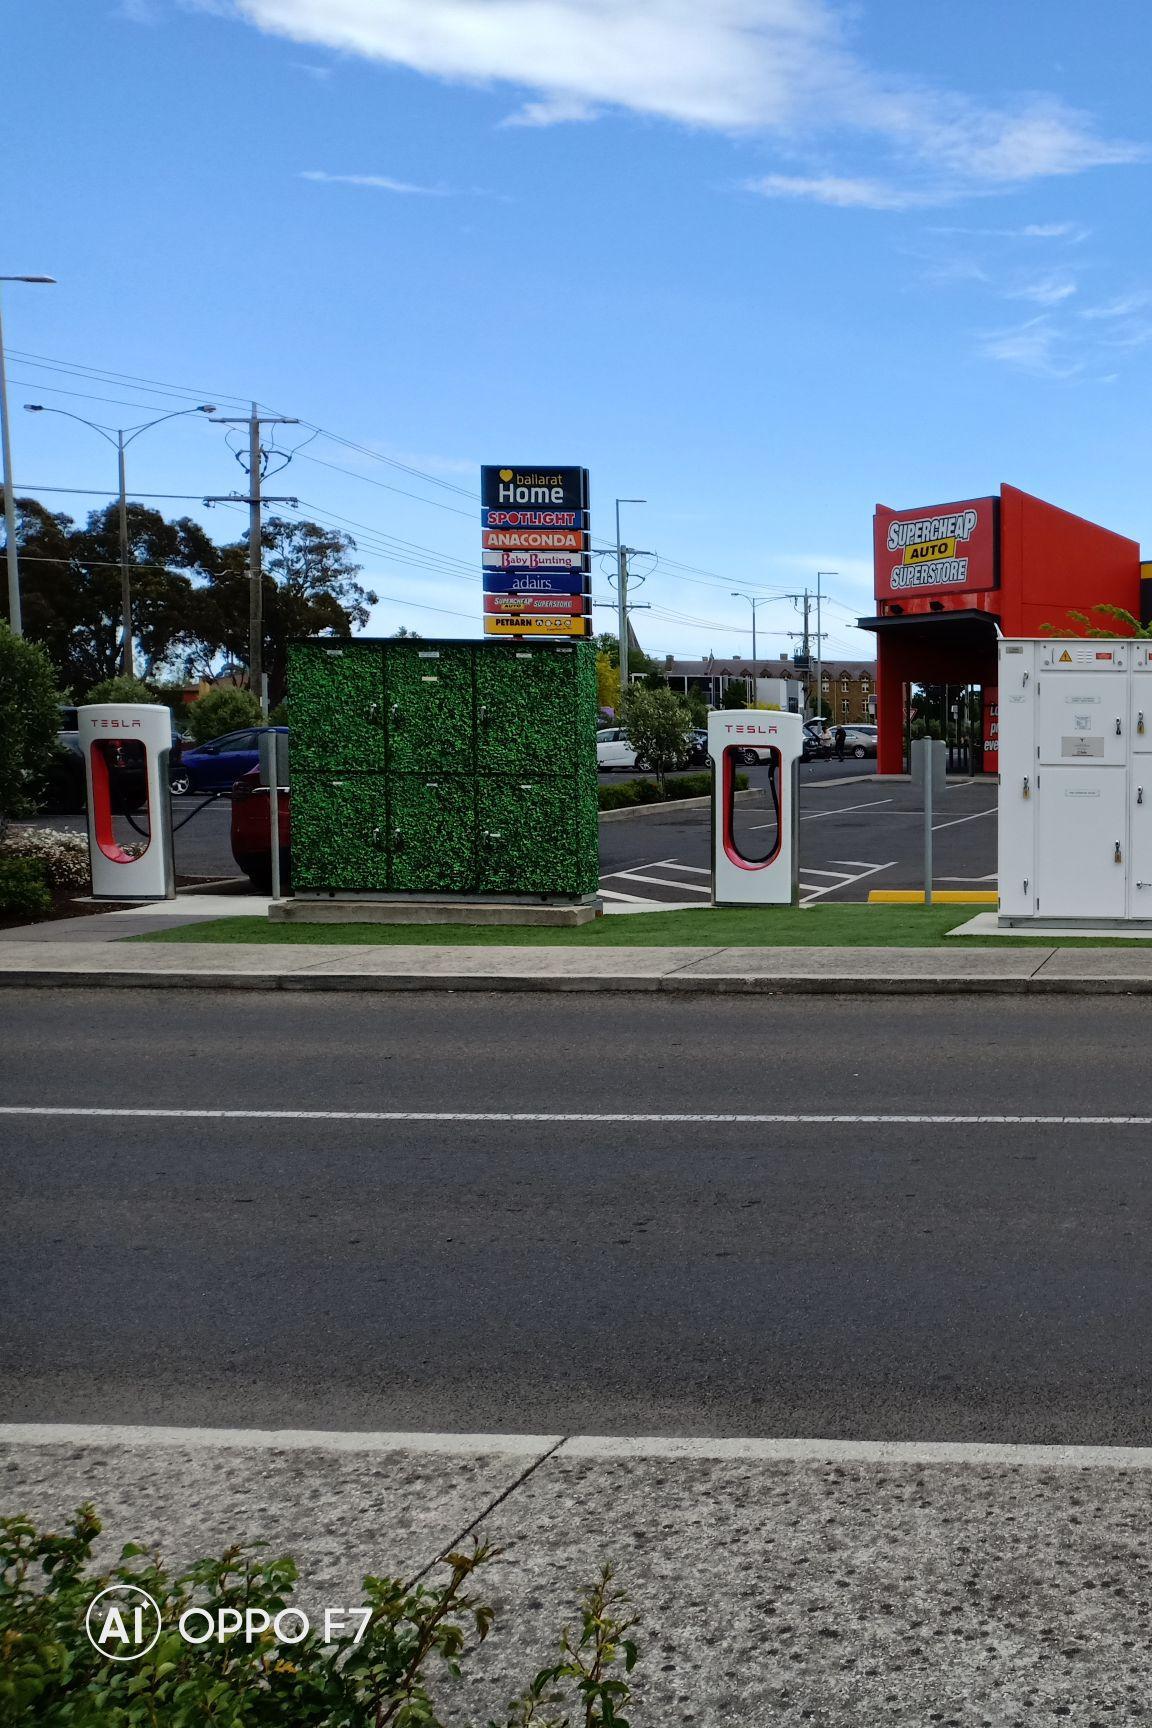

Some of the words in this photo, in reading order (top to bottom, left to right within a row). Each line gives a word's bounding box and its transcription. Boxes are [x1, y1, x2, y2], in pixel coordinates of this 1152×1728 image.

[516, 474, 563, 485] ballarat
[499, 484, 564, 504] Home
[488, 511, 576, 526] SPOTLIGHT
[888, 509, 977, 551] SUPERCHEAP
[488, 533, 577, 547] ANACONDA
[910, 542, 949, 560] AUTO
[501, 553, 528, 568] Baby
[529, 553, 572, 568] Bunting
[890, 557, 968, 589] SUPERSTORE
[512, 575, 552, 590] adairs
[495, 618, 532, 627] PETBARN
[90, 719, 141, 728] TESLA
[724, 724, 778, 734] TESLA
